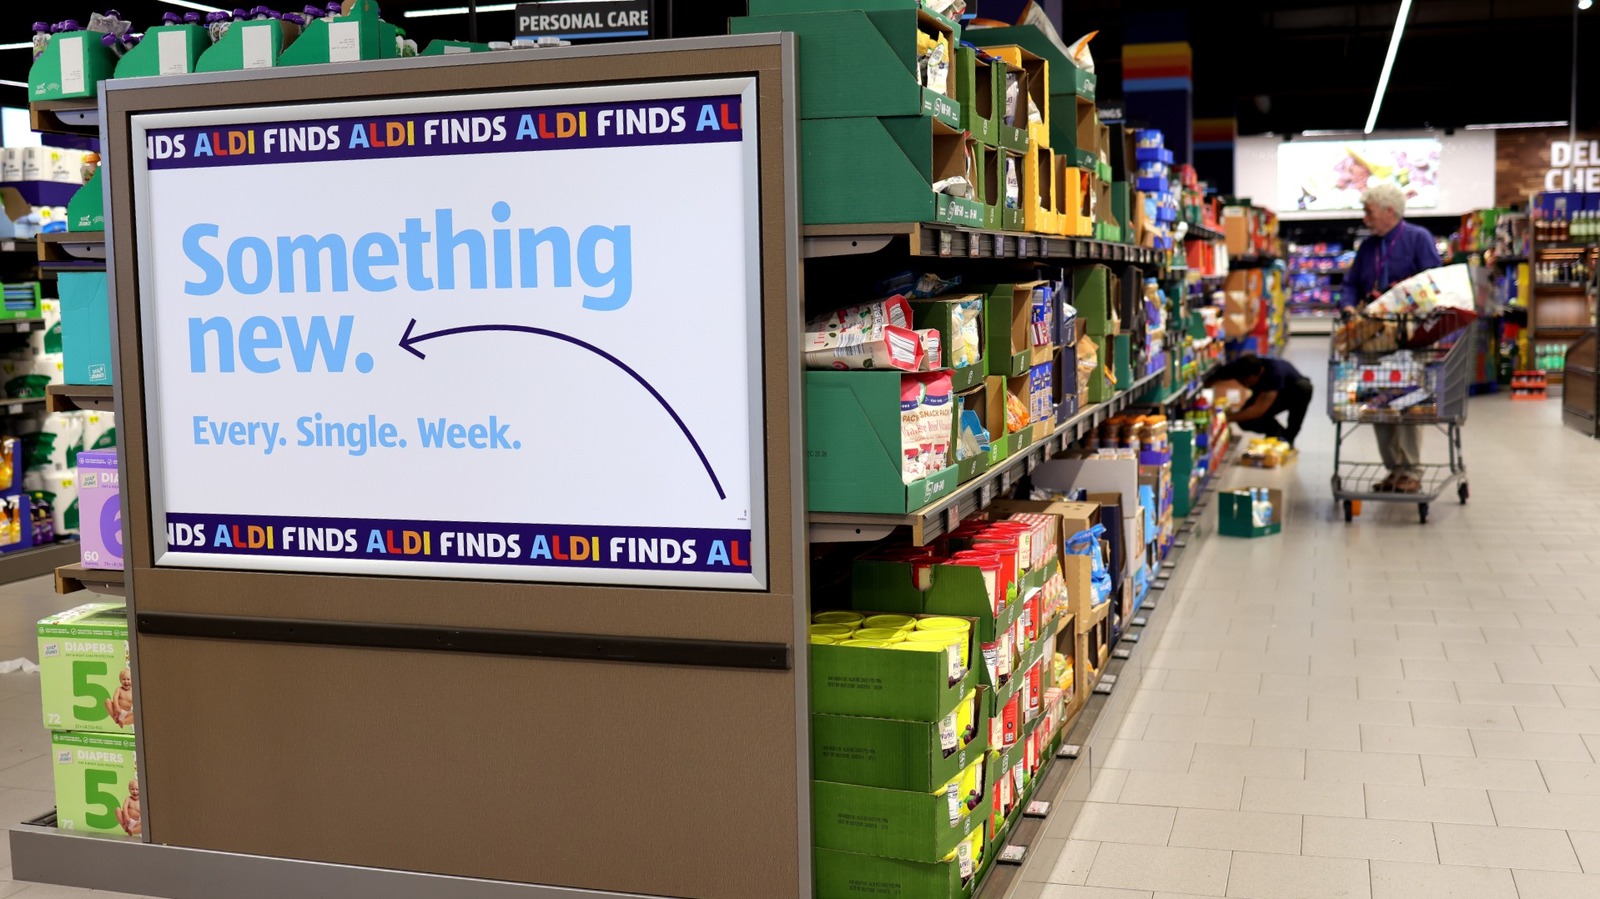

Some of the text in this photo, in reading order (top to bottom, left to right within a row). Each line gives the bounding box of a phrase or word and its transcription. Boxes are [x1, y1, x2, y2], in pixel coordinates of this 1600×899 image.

[519, 10, 649, 32] PERSONAL CARE
[193, 130, 255, 157] ALDI
[264, 125, 340, 153] FINDS
[349, 121, 415, 149] ALDI
[423, 116, 507, 145] FINDS
[516, 112, 587, 140] ALDI
[598, 106, 687, 136] FINDS
[695, 103, 742, 131] AL
[182, 201, 633, 311] Something
[188, 315, 375, 374] new.
[193, 412, 522, 457] Every. Single. Week.
[84, 551, 99, 561] 60
[213, 524, 274, 549] ALDI
[282, 527, 358, 552] FINDS
[366, 529, 431, 555] ALDI
[440, 532, 522, 558] FINDS
[530, 535, 600, 561] ALDI
[609, 537, 698, 564] FINDS
[706, 540, 752, 567] AL
[64, 641, 114, 653] DIAPERS
[72, 660, 111, 721] 5
[48, 713, 62, 725] 72
[77, 750, 123, 763] DIAPERS
[85, 768, 121, 829] 5
[62, 819, 74, 829] 72
